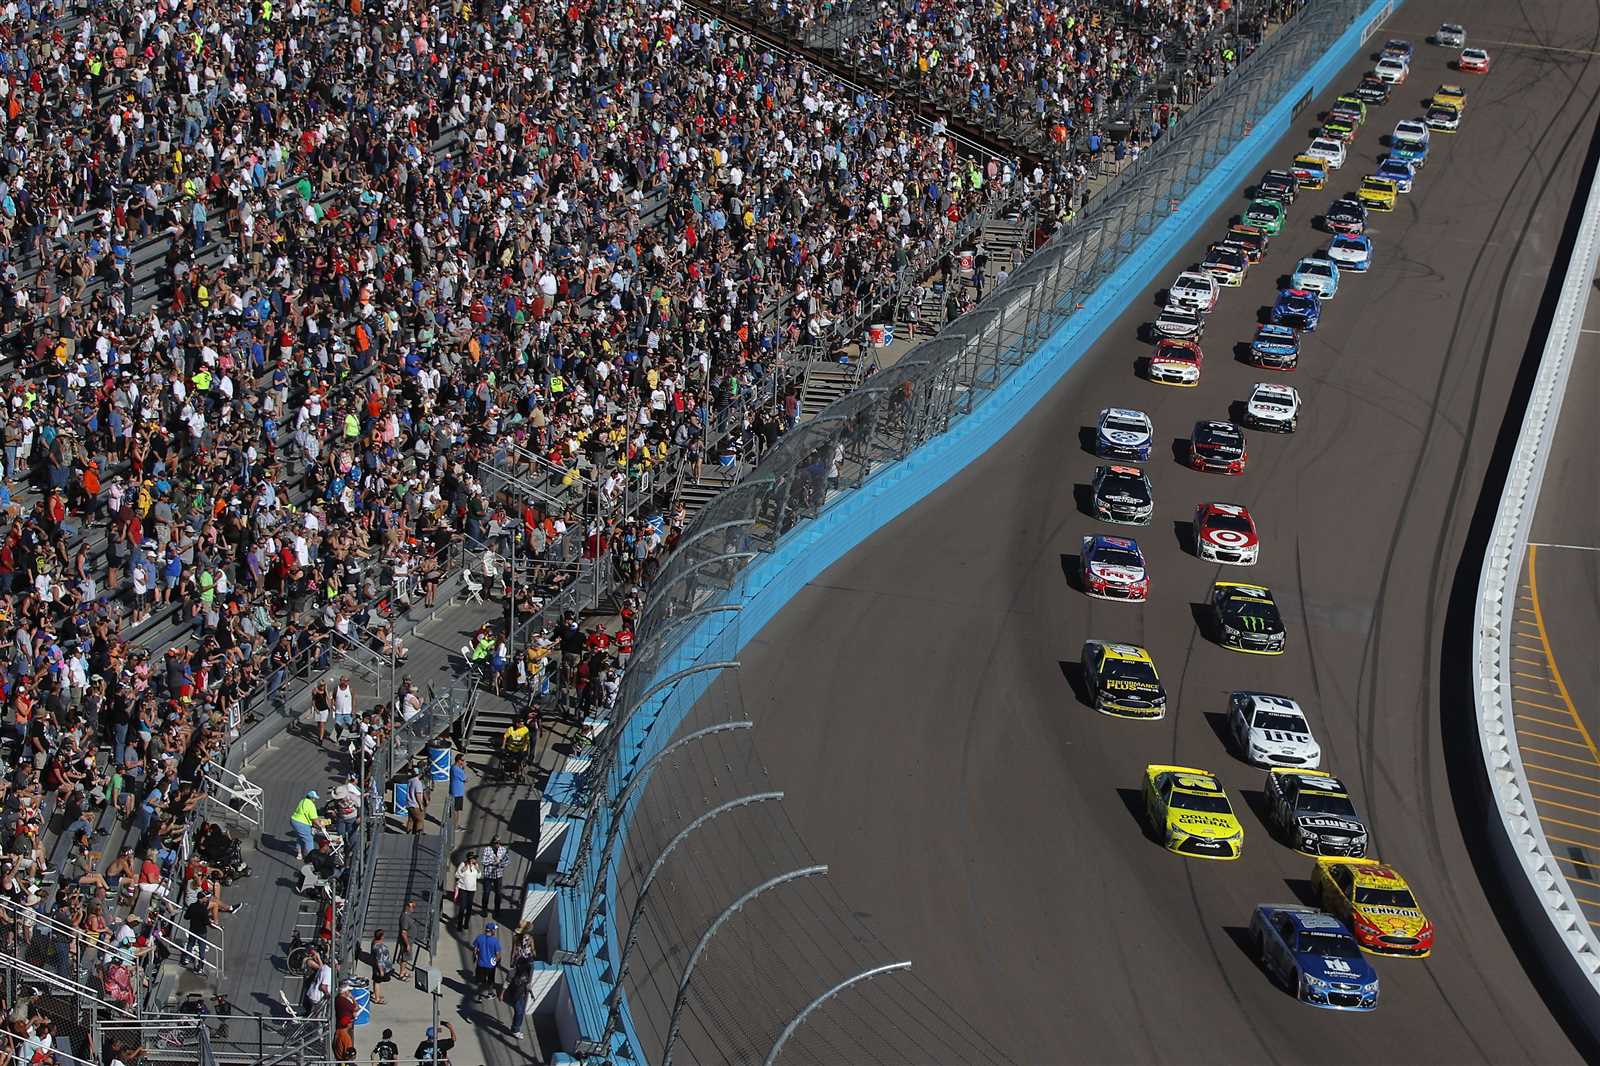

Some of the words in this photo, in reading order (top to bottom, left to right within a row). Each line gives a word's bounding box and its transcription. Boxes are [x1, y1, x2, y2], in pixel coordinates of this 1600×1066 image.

[1179, 818, 1233, 829] GENERAL
[1180, 814, 1227, 823] DOLLAR
[1363, 907, 1419, 917] PENNZOIL
